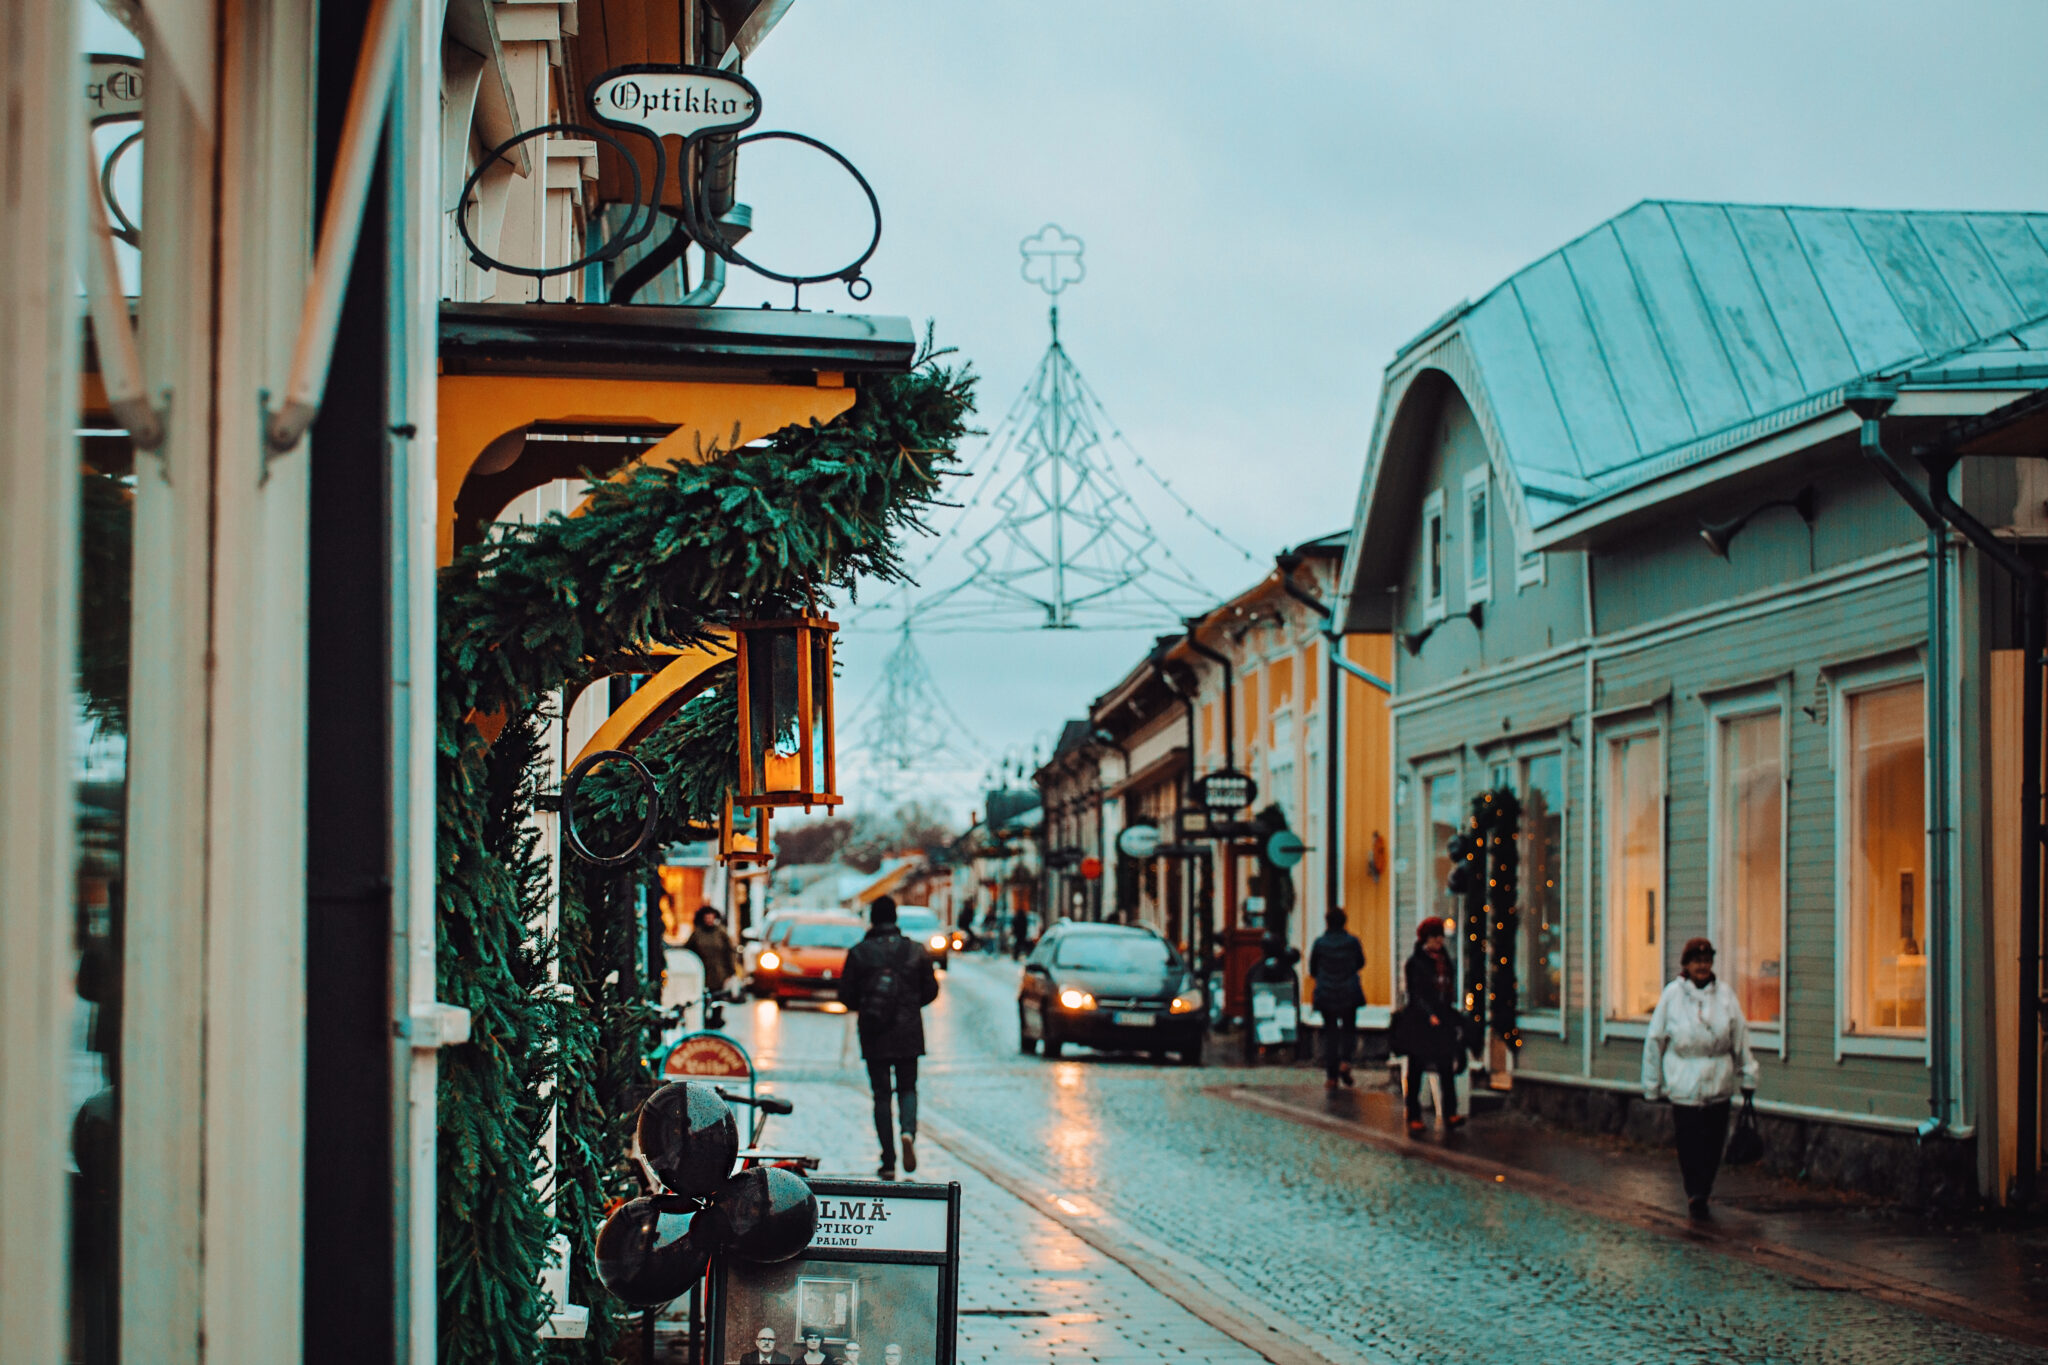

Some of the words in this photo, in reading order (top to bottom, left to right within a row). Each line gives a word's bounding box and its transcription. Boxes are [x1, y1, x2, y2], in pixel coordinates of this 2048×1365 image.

[610, 81, 737, 119] Optikko
[820, 1198, 891, 1221] LMÄ-
[815, 1223, 874, 1235] PTIKOT
[816, 1237, 858, 1246] PALMU
